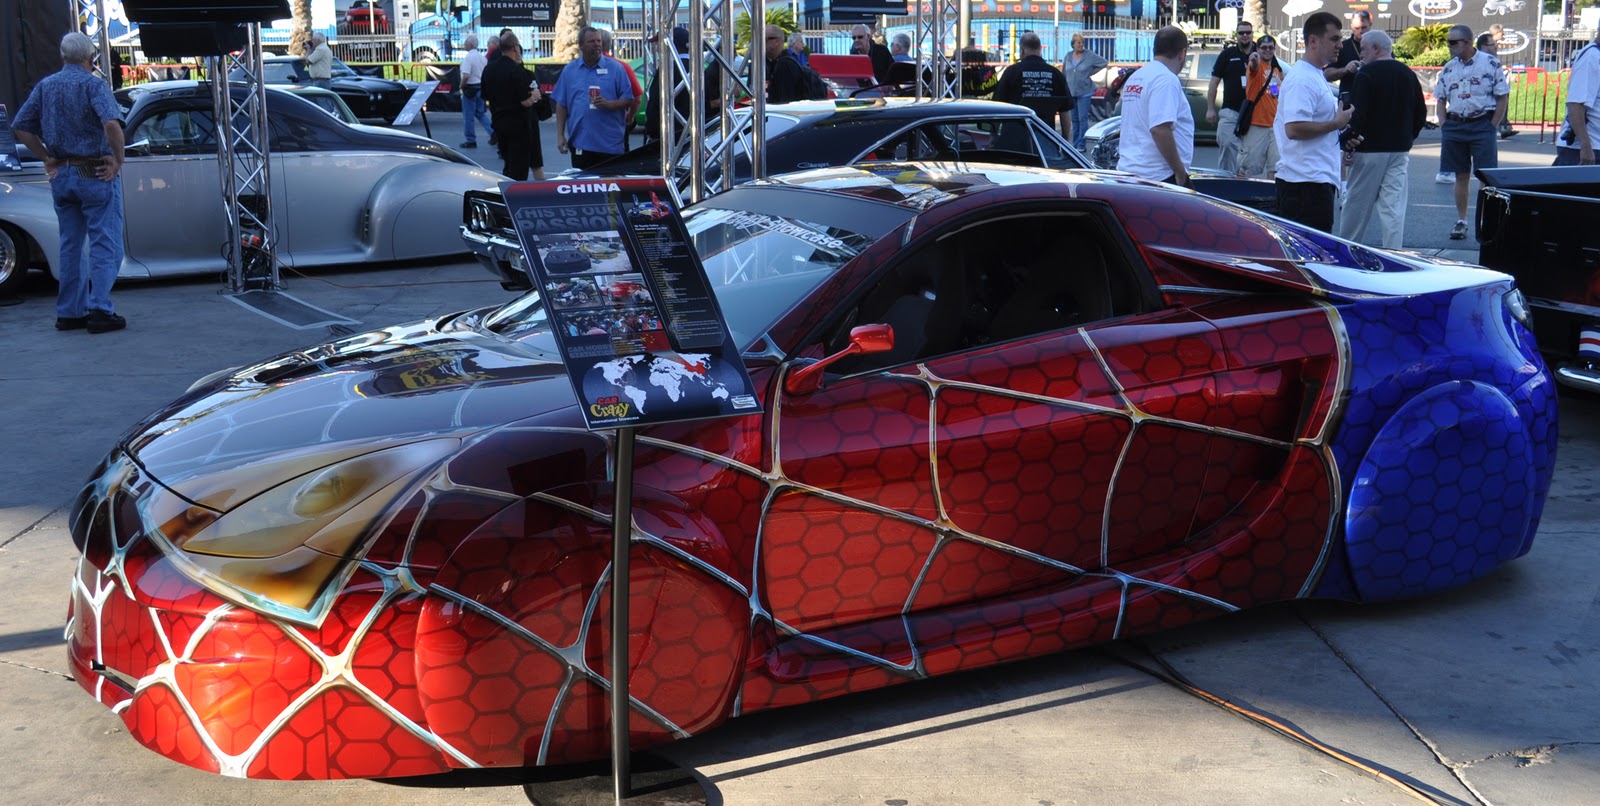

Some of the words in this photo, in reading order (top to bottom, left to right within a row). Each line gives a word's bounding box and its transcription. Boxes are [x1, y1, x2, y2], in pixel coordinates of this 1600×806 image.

[981, 4, 1107, 13] PRODUCTS
[556, 182, 621, 195] CHINA
[517, 207, 555, 219] THIS
[560, 206, 578, 218] IS
[519, 215, 622, 232] PASSION
[597, 395, 619, 405] CAR
[590, 401, 630, 418] Crazy
